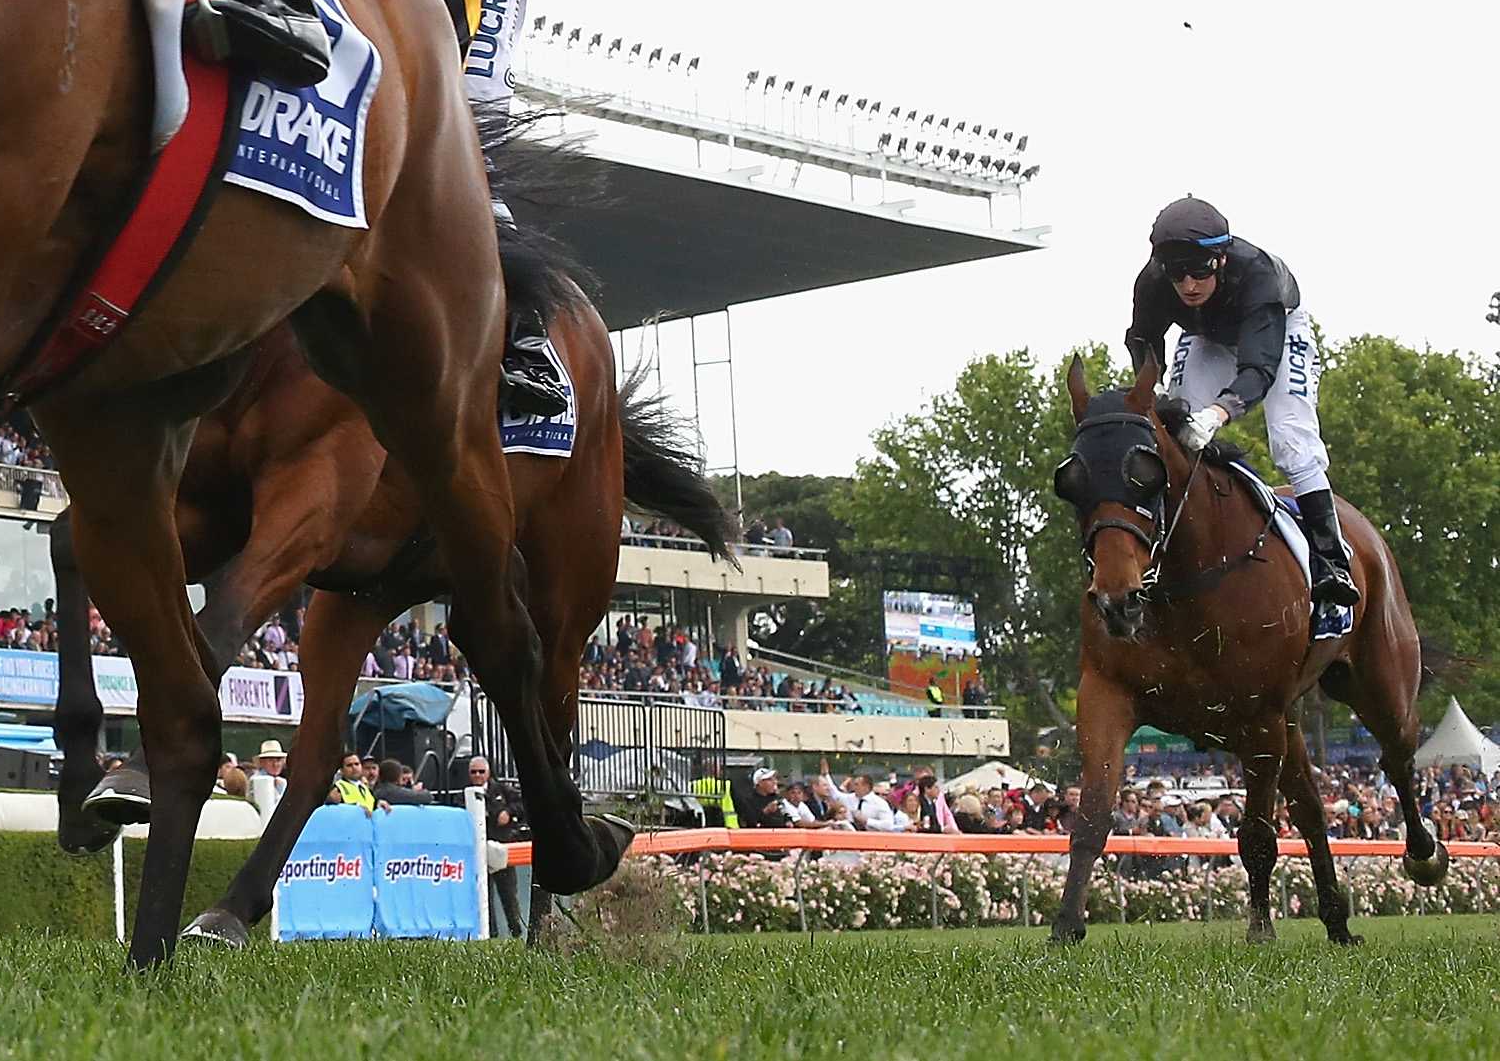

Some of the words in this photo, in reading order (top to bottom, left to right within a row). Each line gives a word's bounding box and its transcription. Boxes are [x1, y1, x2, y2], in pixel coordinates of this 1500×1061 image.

[239, 80, 352, 175] DRAKE
[236, 143, 341, 201] NTERNATIONAL
[1170, 330, 1192, 387] UCRF
[228, 677, 271, 709] FIORENTE
[385, 856, 466, 883] sportingbet
